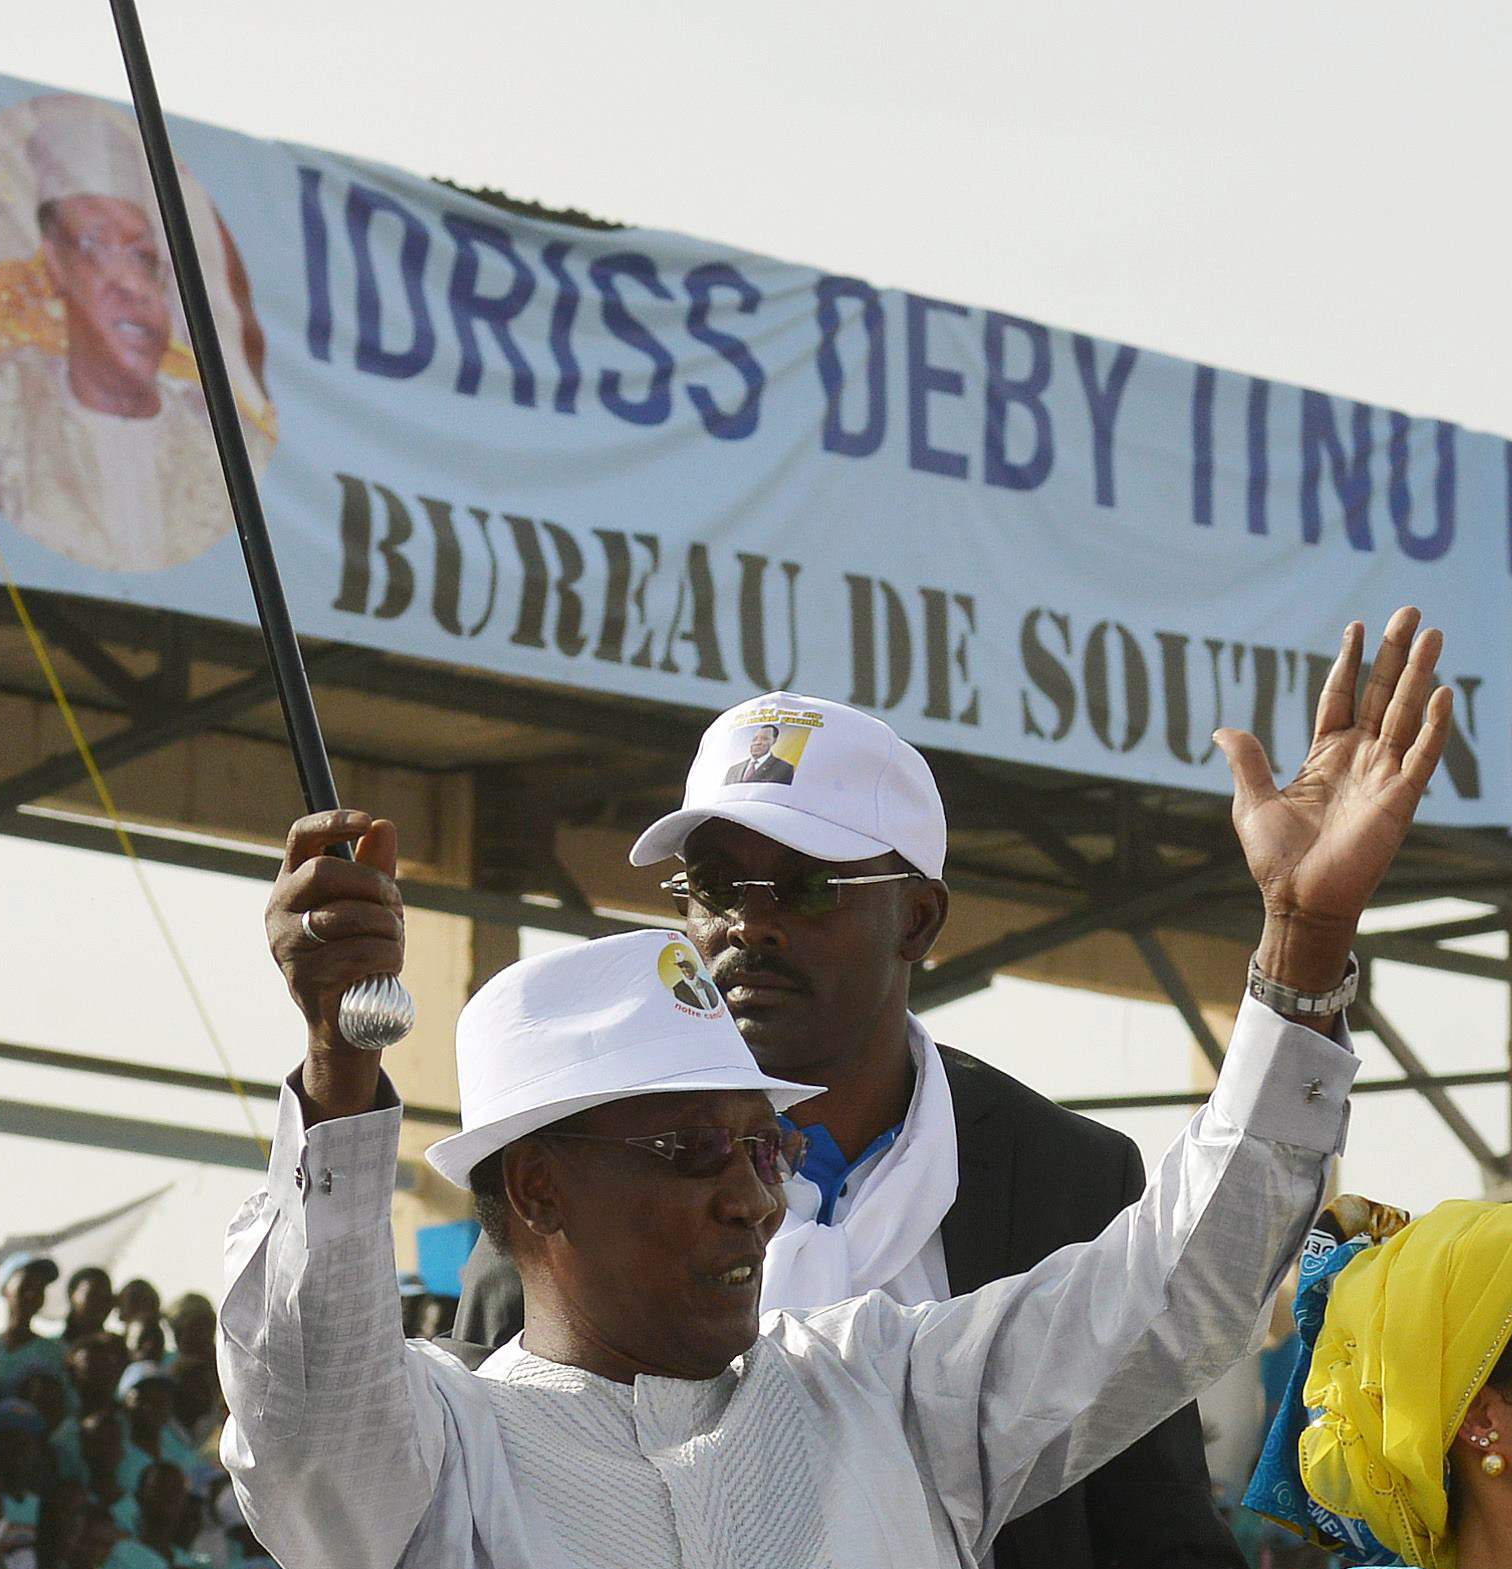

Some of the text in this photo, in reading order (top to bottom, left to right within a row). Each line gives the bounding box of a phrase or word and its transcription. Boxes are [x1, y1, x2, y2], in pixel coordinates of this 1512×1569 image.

[296, 166, 766, 441] IDRISS
[815, 275, 1140, 509] DEBY
[333, 472, 803, 692] BUREAU
[843, 572, 981, 727] DE
[1019, 603, 1484, 799] SOUTN
[674, 1002, 702, 1019] notre
